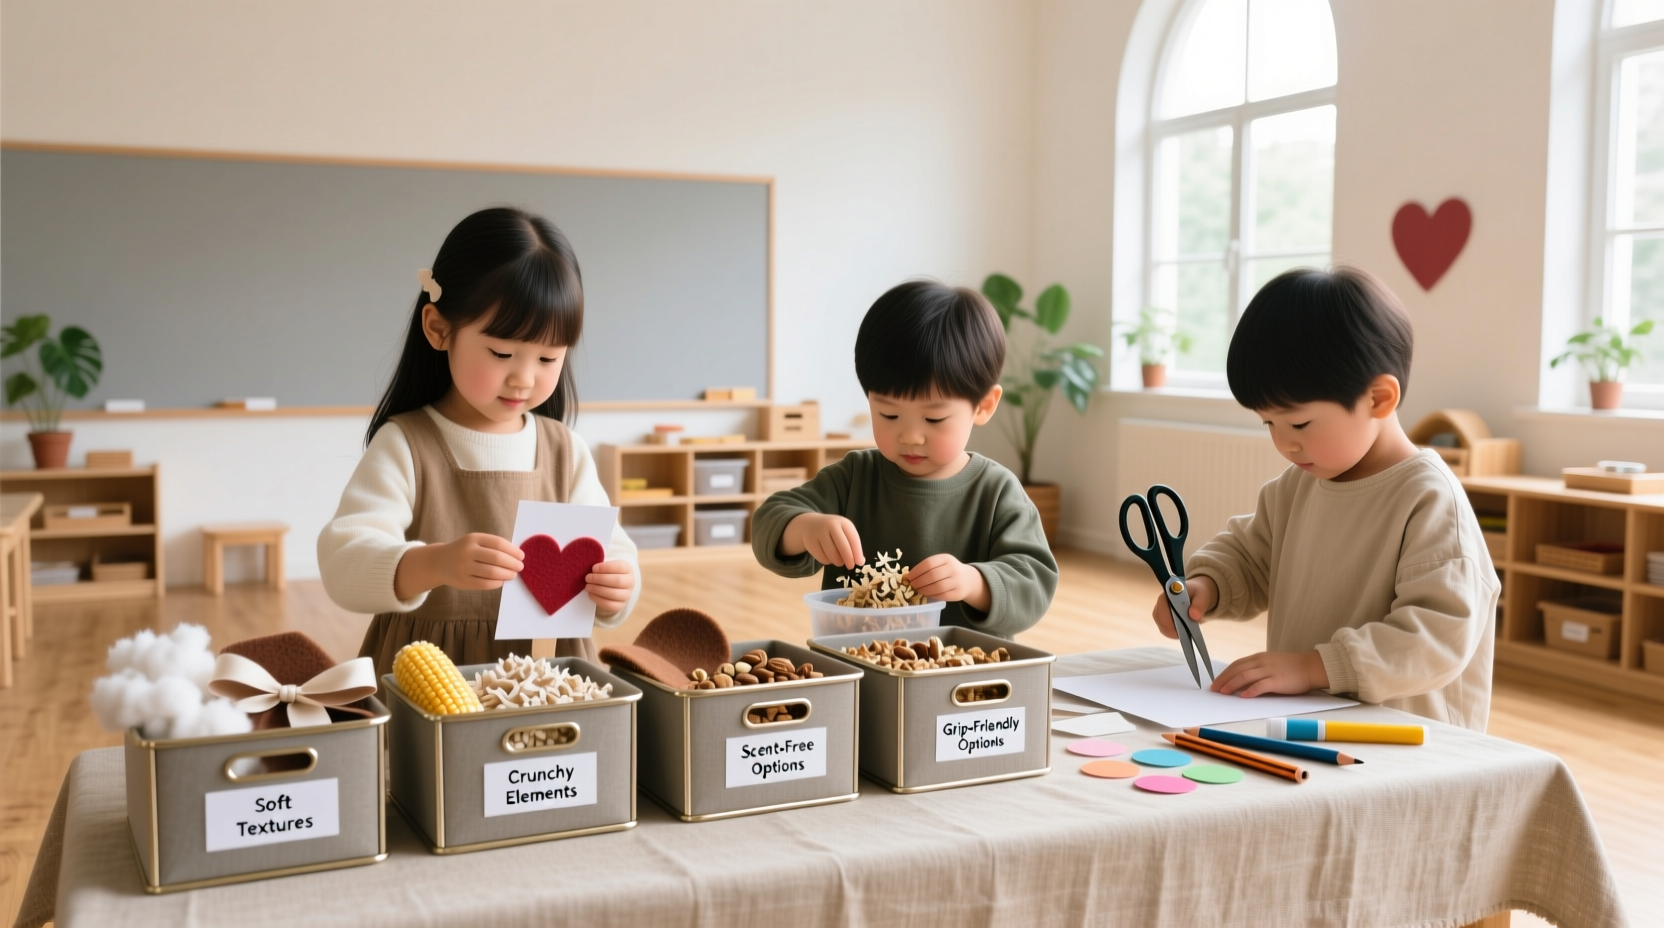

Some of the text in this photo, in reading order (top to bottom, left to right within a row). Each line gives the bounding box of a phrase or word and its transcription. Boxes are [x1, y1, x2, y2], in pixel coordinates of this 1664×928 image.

[740, 740, 815, 759] Scent-Free
[508, 764, 575, 785] Crunchy
[751, 759, 805, 780] Options
[254, 793, 293, 813] Soft
[506, 785, 578, 805] Elements
[236, 817, 315, 837] Textures
